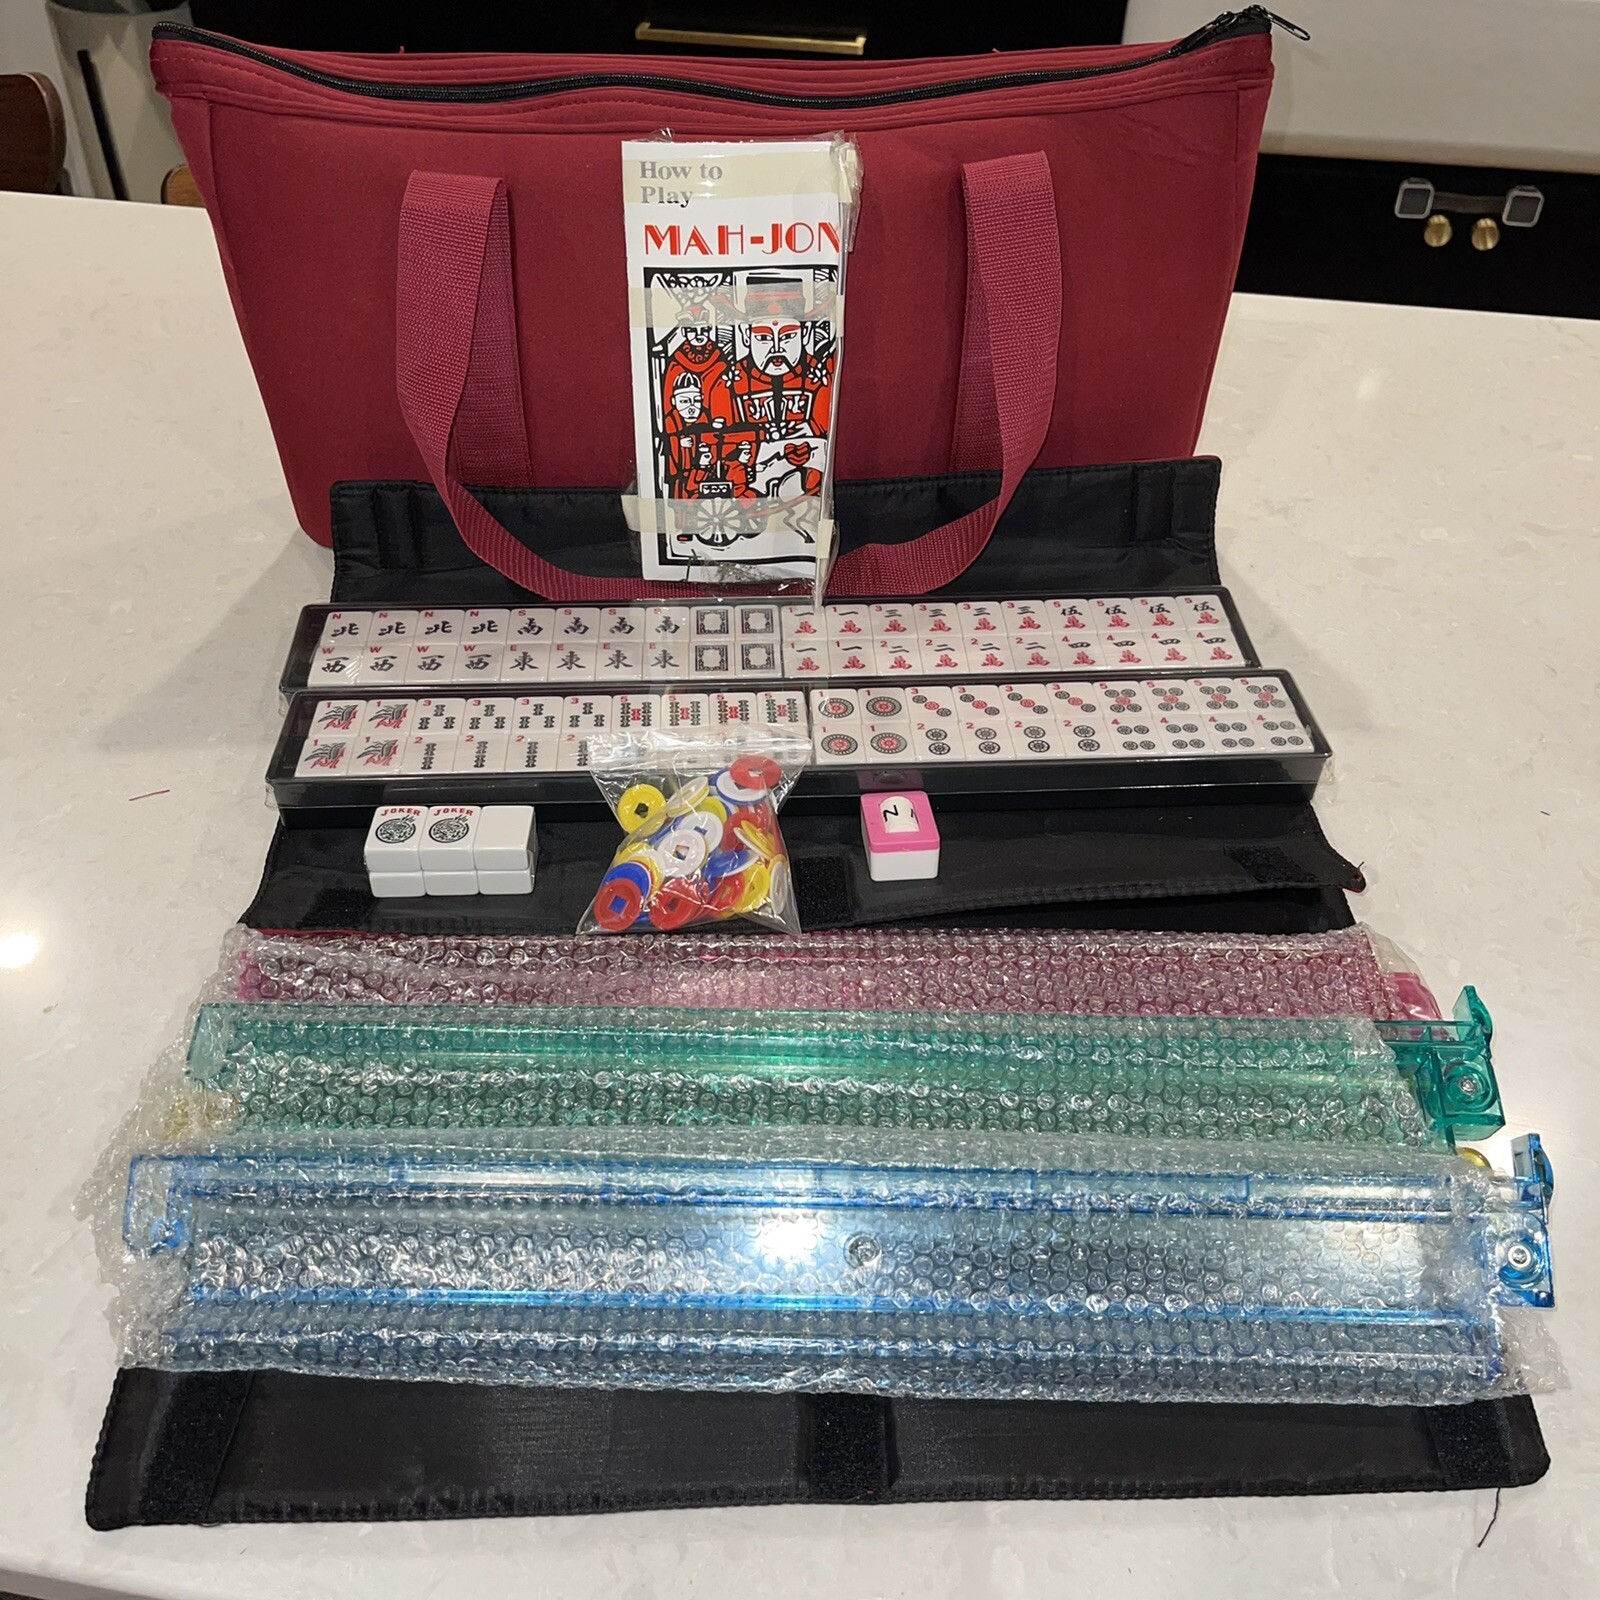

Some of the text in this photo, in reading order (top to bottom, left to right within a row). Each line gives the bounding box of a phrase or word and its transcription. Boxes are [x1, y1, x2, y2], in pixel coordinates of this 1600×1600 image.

[639, 161, 722, 179] How to
[640, 186, 693, 208] Play
[381, 808, 420, 816] JOKER
[434, 808, 473, 816] JOKER
